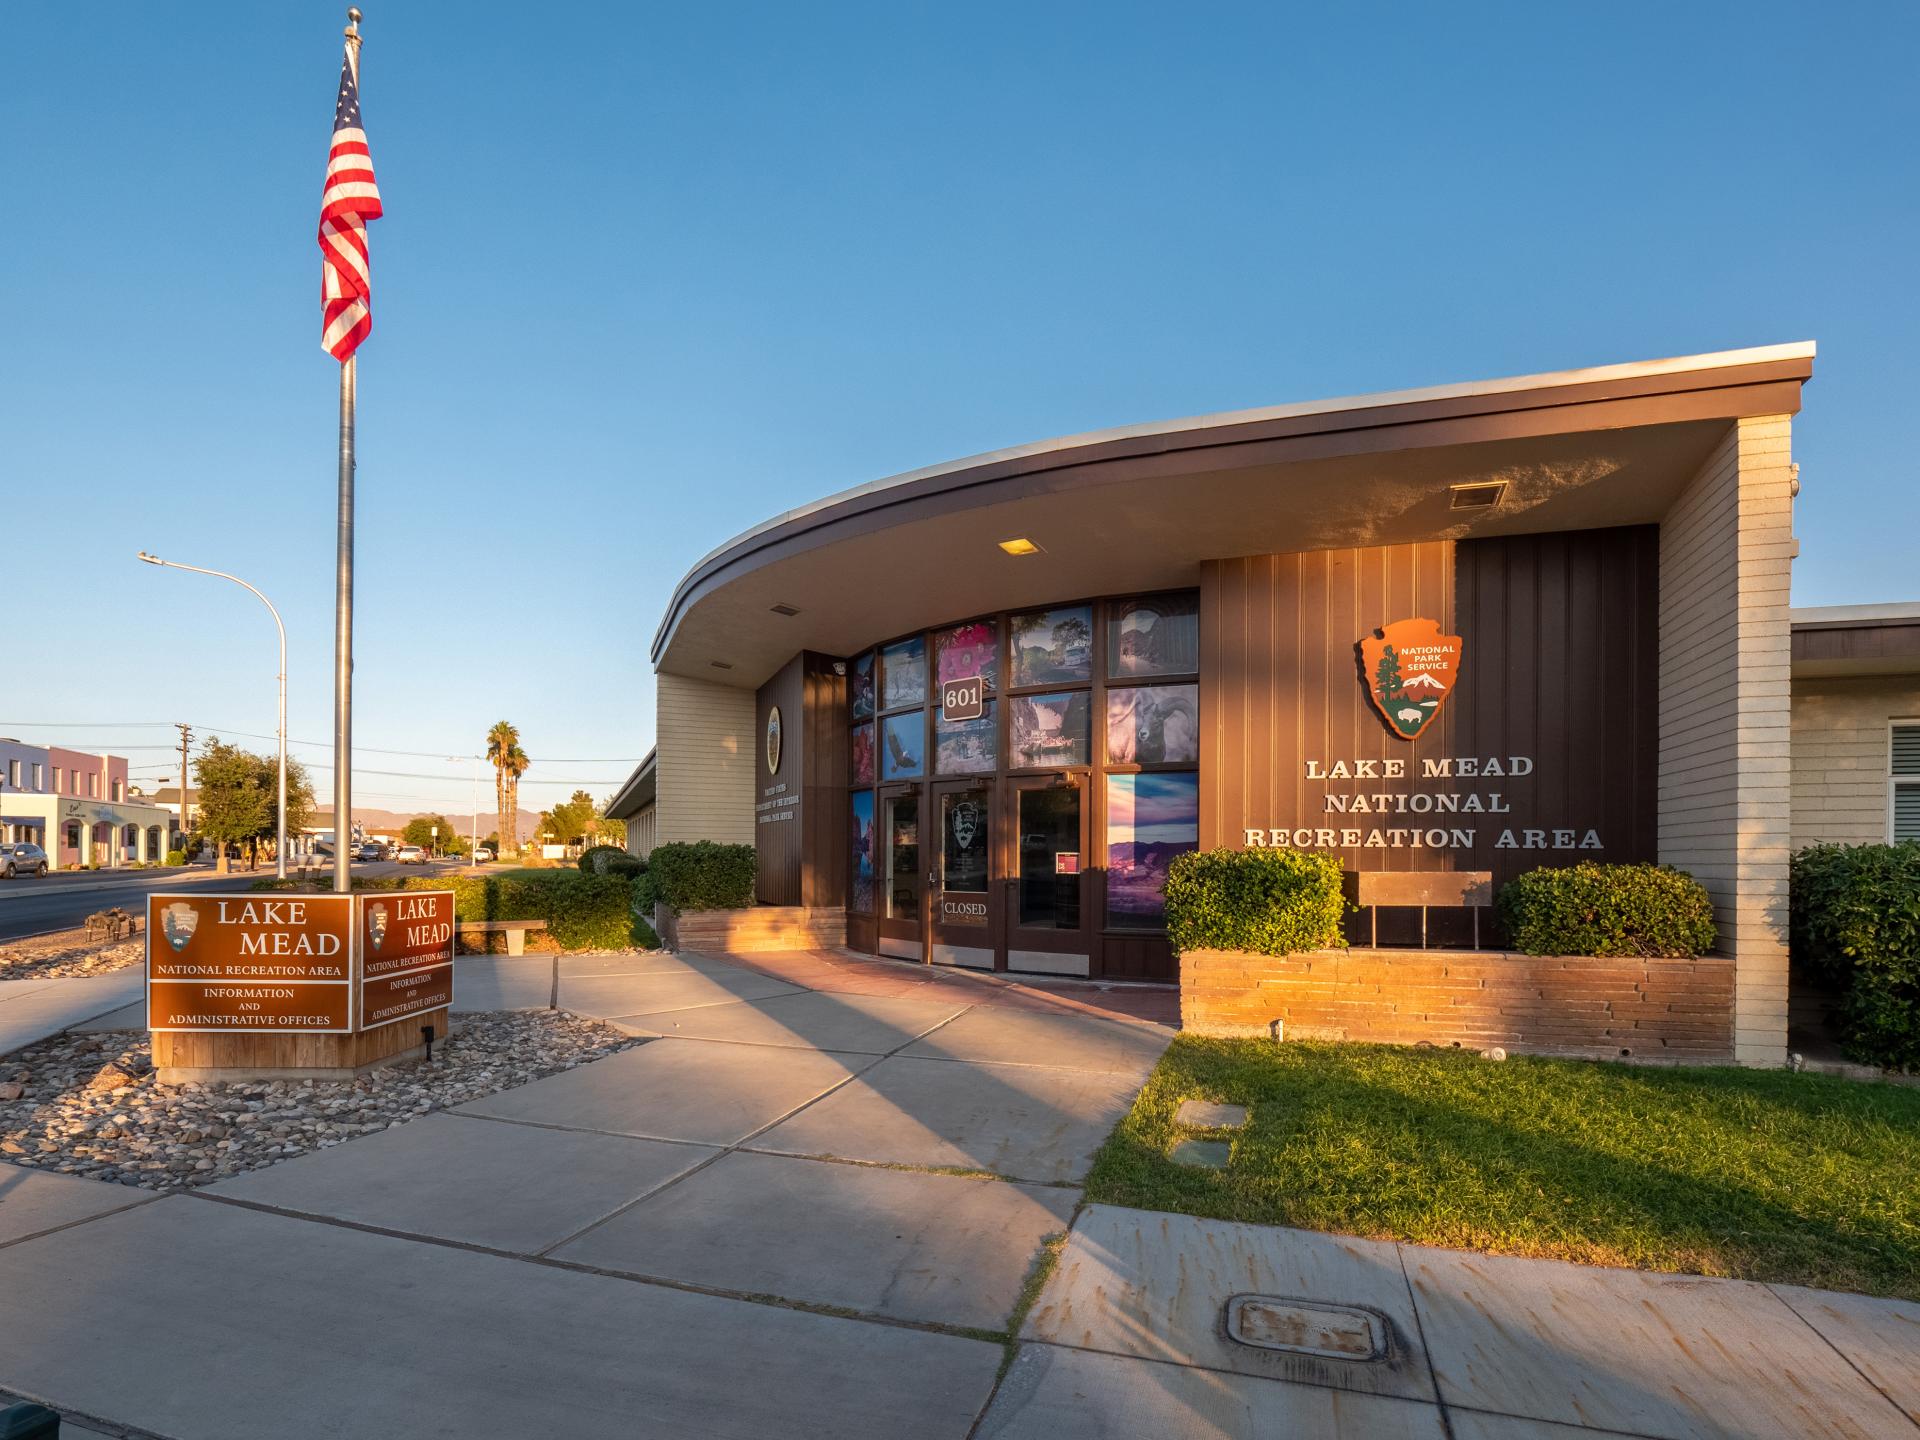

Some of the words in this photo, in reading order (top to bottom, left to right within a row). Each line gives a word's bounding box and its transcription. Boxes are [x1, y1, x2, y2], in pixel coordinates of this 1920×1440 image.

[1401, 645, 1456, 656] NATIONAL
[1414, 655, 1442, 663] PARK
[1407, 662, 1449, 671] SERVICE
[946, 687, 979, 708] 601
[1305, 759, 1405, 780] LAKE
[1421, 756, 1534, 778] MEAD
[1324, 793, 1510, 813] NATIONAL
[1244, 828, 1477, 849] RECREATION
[1494, 829, 1605, 849] AREA
[217, 901, 307, 925] LAKE
[397, 897, 437, 921] LAKE
[944, 902, 987, 915] CLOSED
[239, 932, 341, 956] MEAD
[406, 922, 450, 948] MEAD
[157, 965, 222, 976] NATIONAL
[226, 966, 306, 976] RECREATION
[308, 966, 342, 976] AREA
[366, 959, 399, 974] NATIONAL
[400, 952, 437, 967] RECREATION
[436, 950, 451, 961] AREA
[390, 973, 432, 991] INFORMATION
[204, 988, 295, 999] INFORMATION
[406, 989, 417, 998] AND
[238, 1002, 261, 1011] AND
[371, 998, 424, 1021] ADMINISTRATIVE
[423, 992, 446, 1007] OFFICES
[167, 1014, 276, 1026] ADMINISTRATIVE
[278, 1015, 331, 1026] OFFICES
